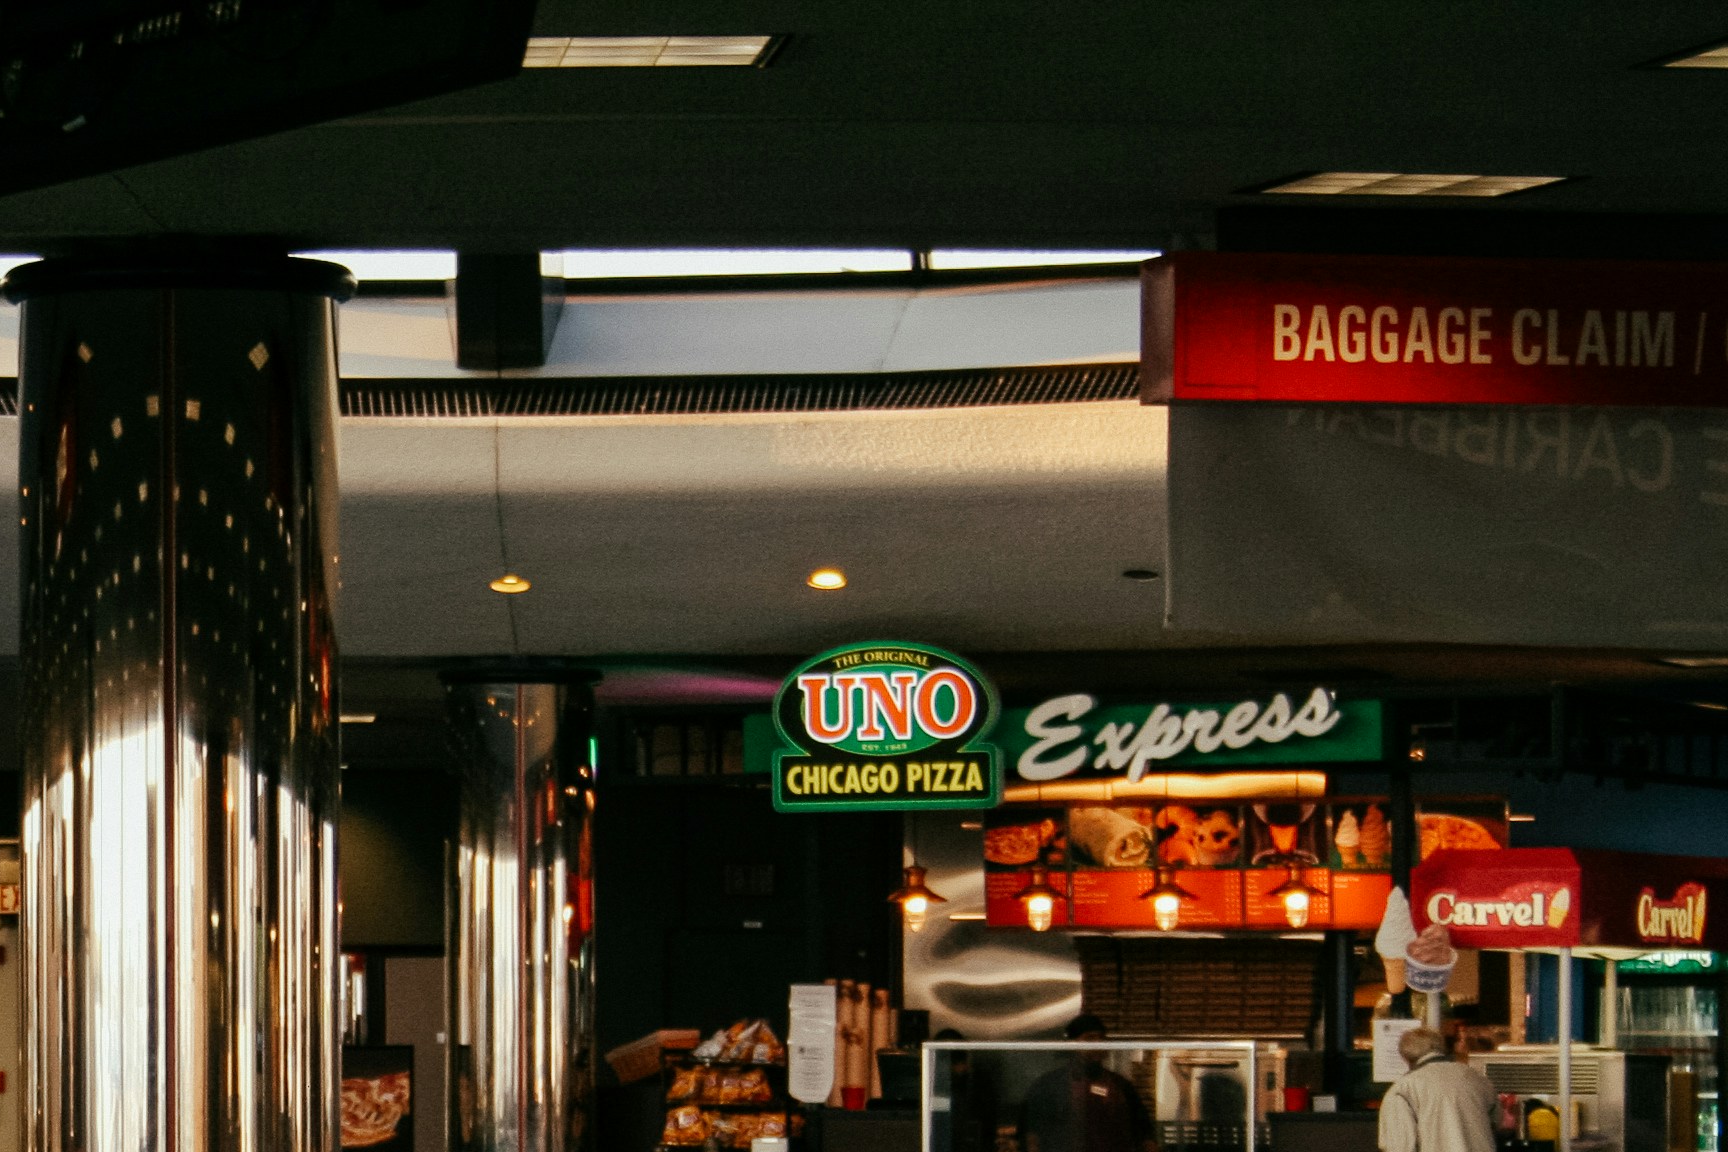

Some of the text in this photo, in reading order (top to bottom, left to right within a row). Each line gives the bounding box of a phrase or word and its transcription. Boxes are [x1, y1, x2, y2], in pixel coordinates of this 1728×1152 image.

[1273, 303, 1493, 365] BAGGAGE
[1512, 307, 1675, 368] CLAIM
[832, 650, 930, 669] THE ORIGINAL
[797, 667, 977, 743] UNO
[1016, 687, 1343, 783] Express
[786, 761, 984, 795] CHICAGO PIZZA
[0, 886, 19, 912] EX
[1426, 892, 1545, 927] Carvel
[1637, 894, 1694, 940] Carvel
